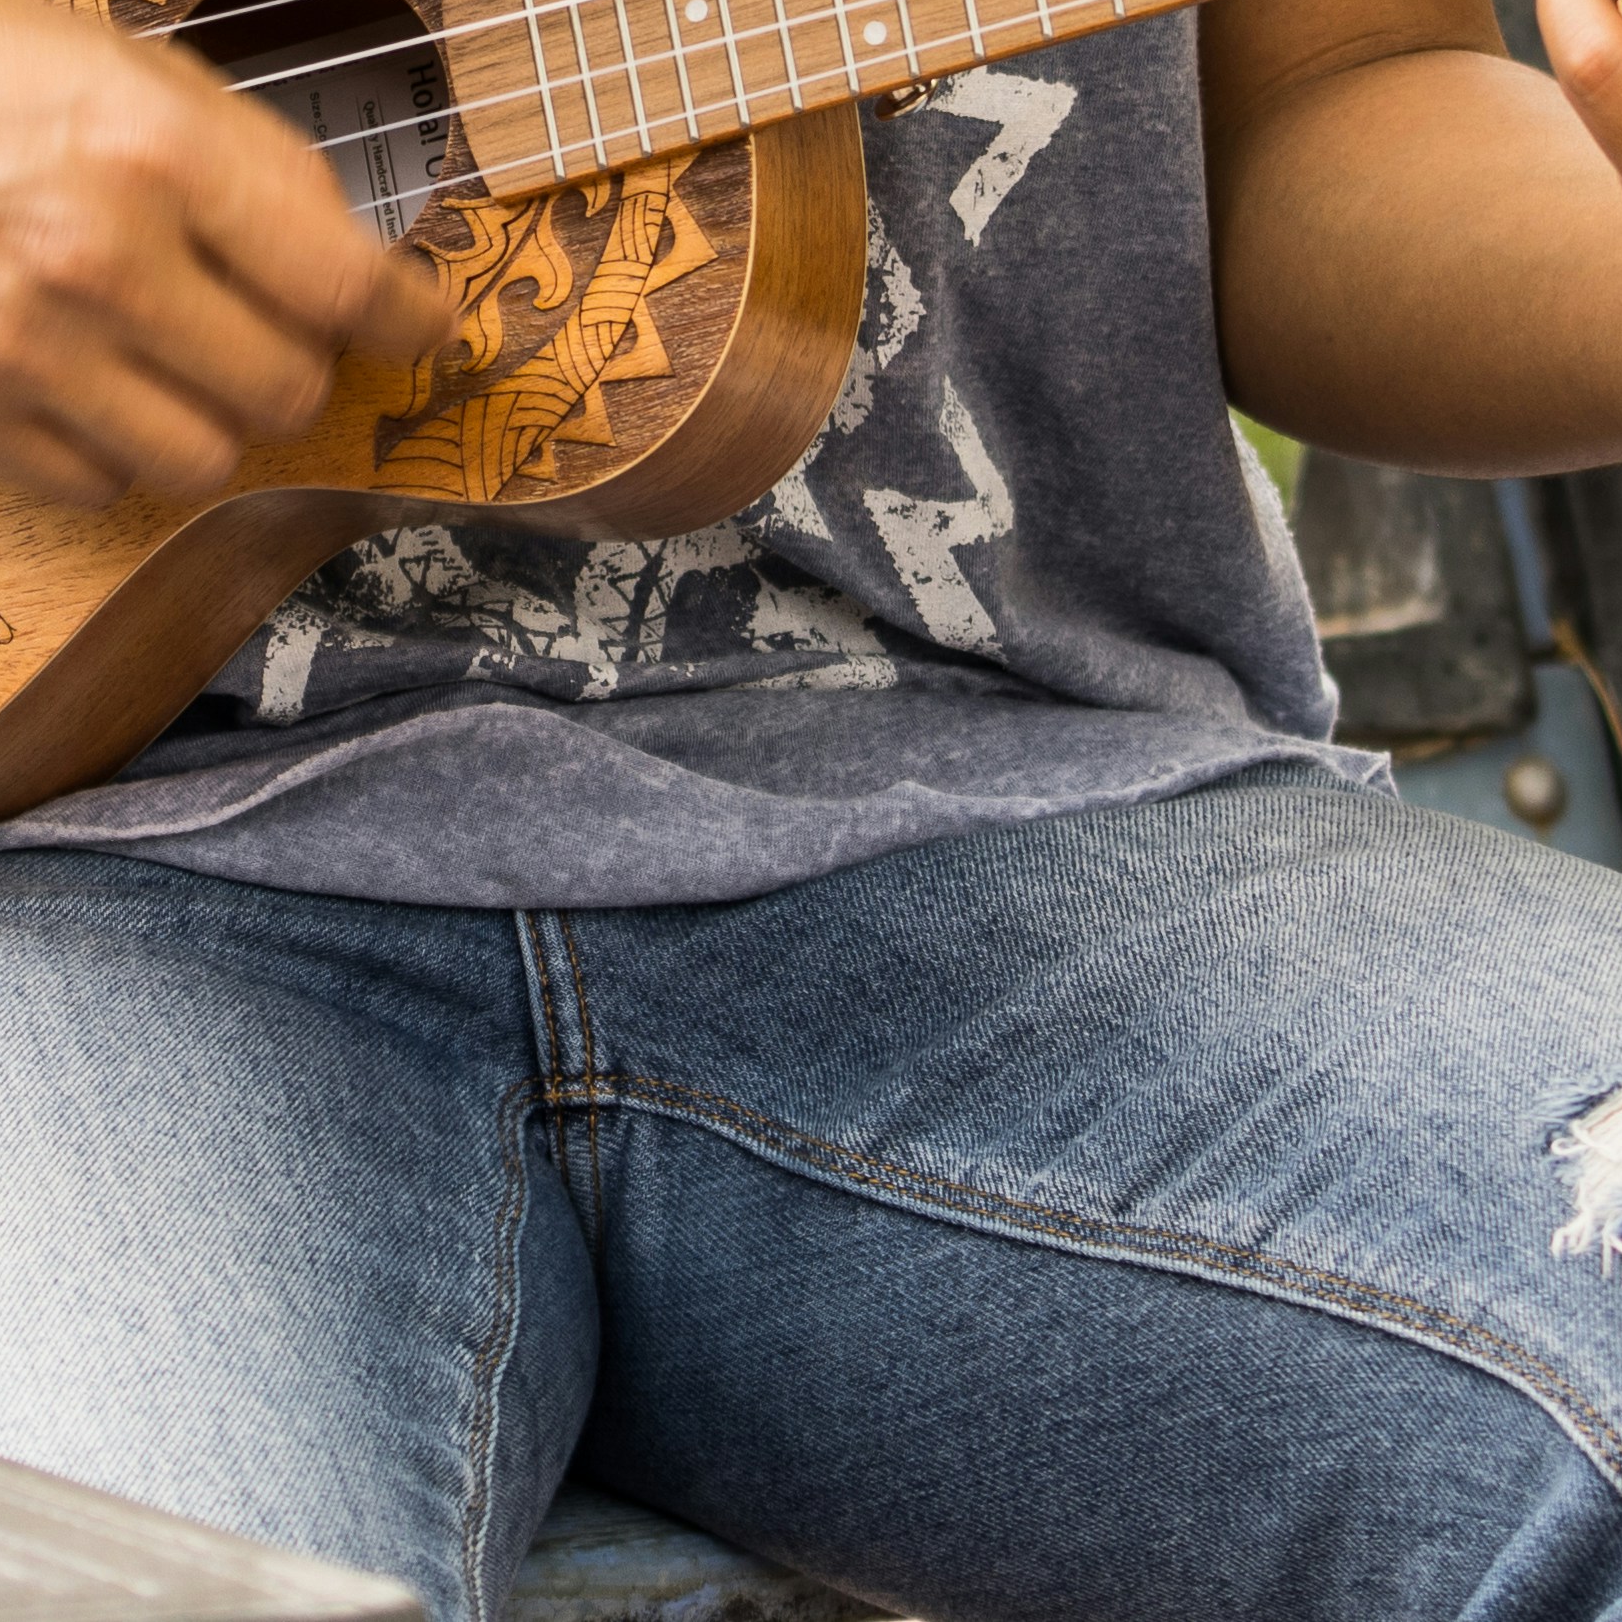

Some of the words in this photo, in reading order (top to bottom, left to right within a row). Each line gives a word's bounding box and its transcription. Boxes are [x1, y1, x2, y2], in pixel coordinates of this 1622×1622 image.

[407, 60, 448, 146] Hola!
[363, 100, 379, 142] Qualy
[372, 144, 395, 216] Handcrafed
